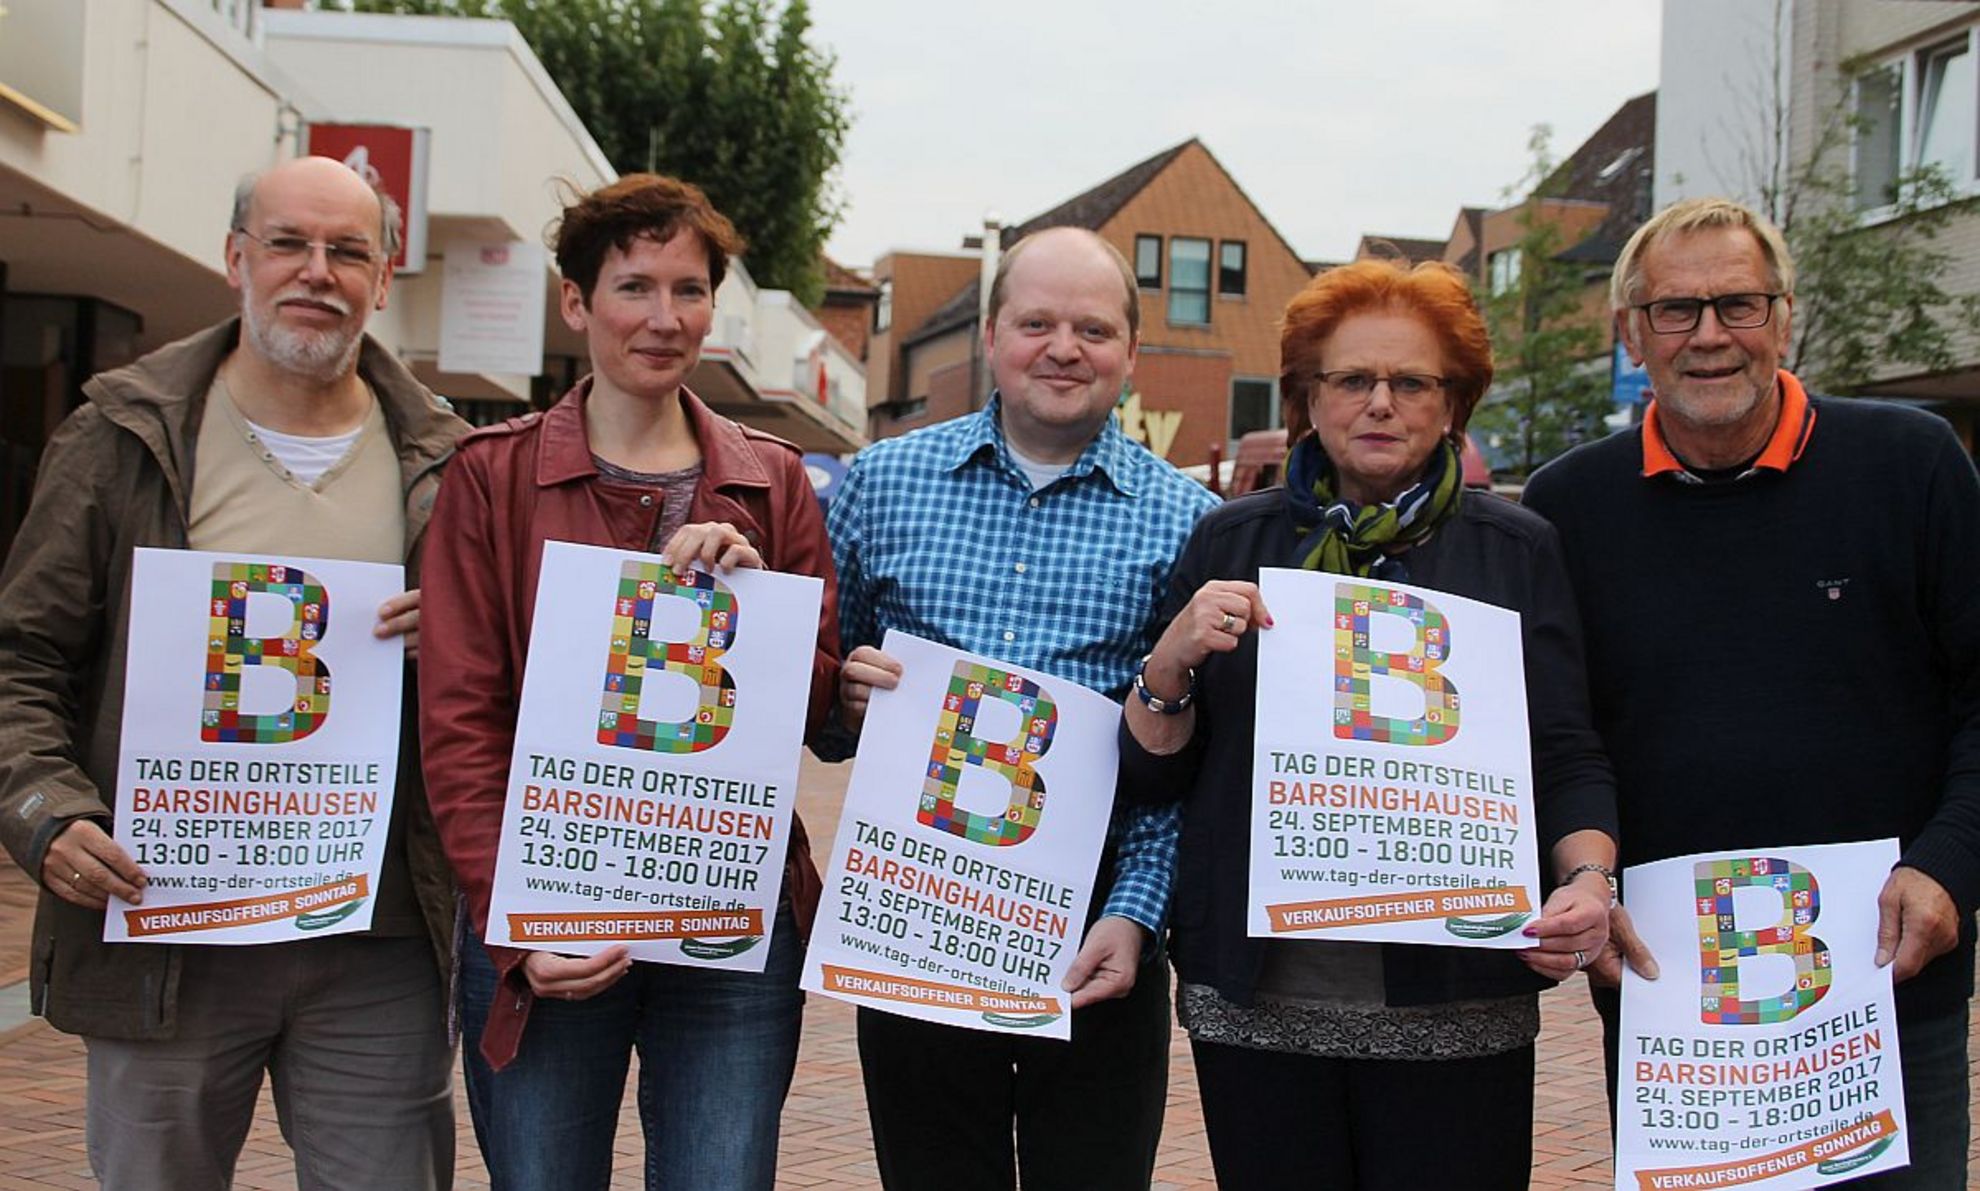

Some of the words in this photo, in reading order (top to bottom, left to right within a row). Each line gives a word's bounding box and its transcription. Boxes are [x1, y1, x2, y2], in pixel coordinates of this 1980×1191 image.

[1816, 578, 1850, 588] GANT
[136, 759, 181, 781] TAG
[190, 760, 239, 782] DER
[247, 762, 378, 784] ORTSTEILE
[529, 755, 576, 781] TAG
[583, 762, 634, 788] DER
[642, 770, 777, 808] ORTSTEILE
[1270, 752, 1317, 775] TAG
[1325, 755, 1375, 778] DER
[1384, 760, 1516, 797] ORTSTEILE
[132, 788, 377, 816] BARSINGHAUSEN
[522, 785, 773, 840] BARSINGHAUSEN
[1269, 781, 1518, 825] BARSINGHAUSEN
[132, 819, 167, 838] 24.
[175, 819, 311, 840] SEPTEMBER
[319, 819, 373, 839] 2017
[520, 816, 555, 840] 24.
[563, 822, 702, 858] SEPTEMBER
[709, 840, 768, 866] 2017
[1269, 810, 1304, 831] 24.
[1313, 813, 1453, 838] SEPTEMBER
[1460, 822, 1519, 845] 2017
[136, 844, 210, 865] 13:00
[237, 844, 308, 865] 18:00
[316, 842, 364, 864] UHR
[521, 842, 597, 871] 13:00
[624, 856, 698, 885] 18:00
[705, 865, 758, 892] UHR
[855, 821, 895, 851] TAG
[901, 837, 947, 869] DER
[952, 855, 1074, 910] ORTSTEILE
[1274, 835, 1349, 859] 13:00
[1377, 840, 1452, 864] 18:00
[1461, 845, 1515, 870] UHR
[140, 901, 289, 929] VERKAUFSOFFENER
[295, 883, 357, 910] SONNTAG
[845, 848, 1068, 939] BARSINGHAUSEN
[1282, 898, 1435, 927] VERKAUFSOFFENER
[1442, 893, 1515, 912] SONNTAG
[522, 920, 674, 936] VERKAUFSOFFENER
[680, 915, 750, 932] SONNTAG
[839, 901, 908, 940] 13:00
[929, 930, 996, 967] 18:00
[1002, 951, 1050, 984] UHR
[840, 877, 872, 902] 24.
[879, 888, 1002, 944] SEPTEMBER
[1007, 930, 1062, 960] 2017
[835, 974, 974, 1006] VERKAUFSOFFENER
[980, 995, 1047, 1011] SONNTAG
[1637, 1037, 1684, 1056] TAG
[1693, 1040, 1744, 1058] DER
[1754, 1003, 1878, 1057] ORTSTEILE
[1635, 1029, 1881, 1086] BARSINGHAUSEN
[1636, 1087, 1673, 1105] 24.
[1681, 1078, 1821, 1106] SEPTEMBER
[1829, 1055, 1881, 1090] 2017
[1641, 1108, 1719, 1130] 13:00
[1748, 1099, 1821, 1129] 18:00
[1829, 1080, 1879, 1111] UHR
[1651, 1151, 1807, 1189] VERKAUFSOFFENER
[1813, 1121, 1882, 1158] SONNTAG
